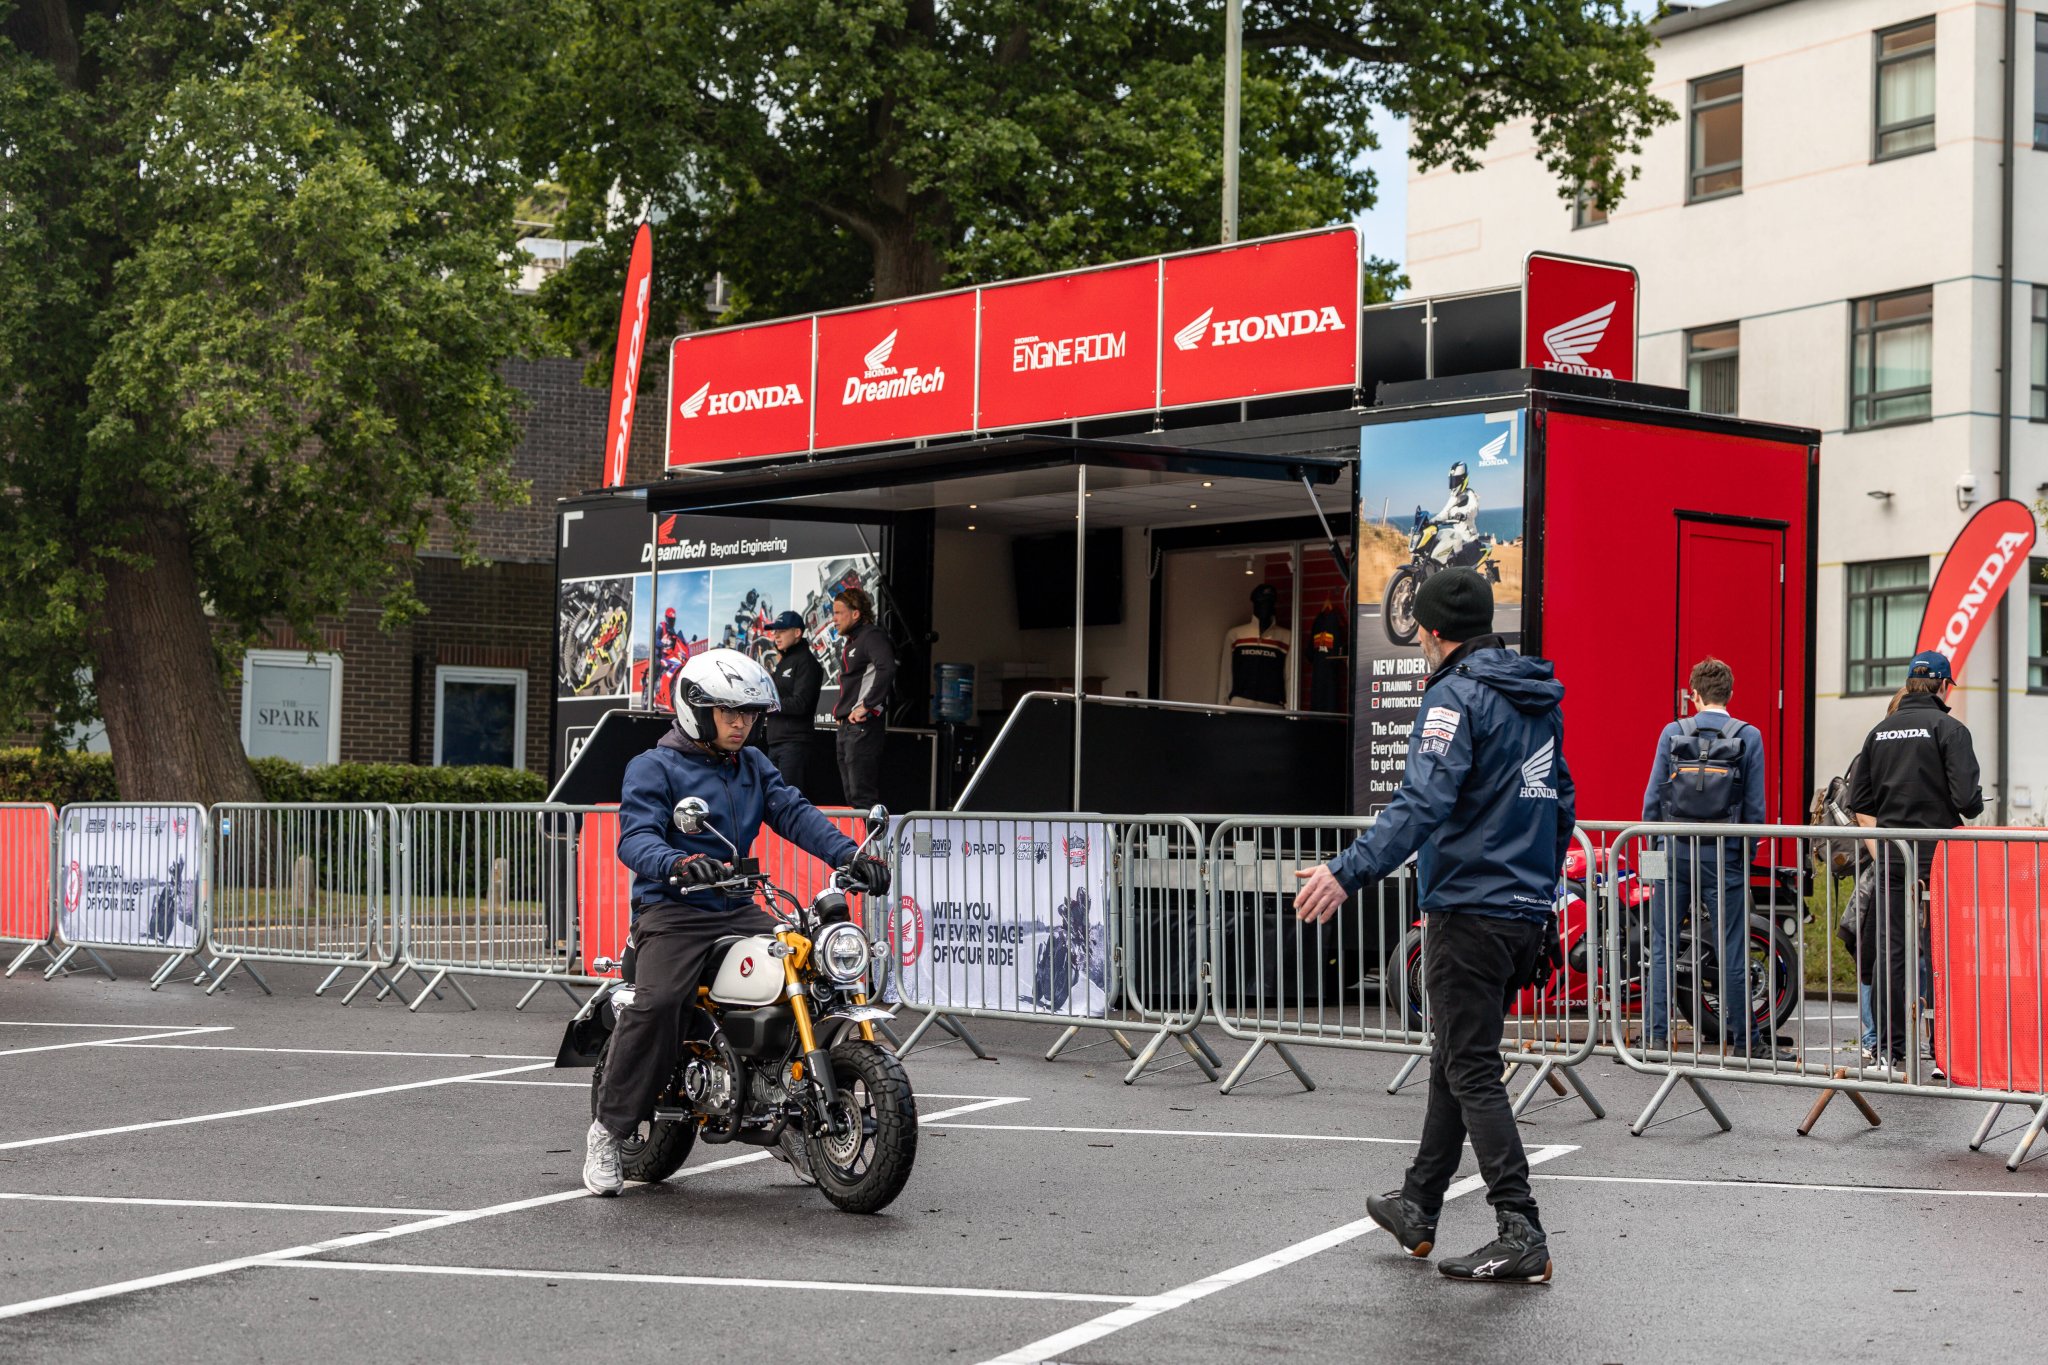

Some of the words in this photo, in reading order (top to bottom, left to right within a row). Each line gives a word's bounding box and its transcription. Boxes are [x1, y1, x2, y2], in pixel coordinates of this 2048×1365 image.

[1212, 306, 1345, 347] HONDA
[1014, 335, 1040, 345] HONDA
[1013, 338, 1073, 373] ENGINE
[1074, 331, 1126, 364] ROOM
[613, 272, 651, 487] ONDA
[864, 366, 898, 379] HONDA
[842, 366, 945, 406] DreamTech
[707, 383, 804, 416] HONDA
[1479, 458, 1509, 468] HONDA
[641, 539, 707, 563] DeamTech
[710, 540, 740, 559] Beyond
[741, 537, 788, 556] Engineering
[1241, 648, 1277, 658] HONDA
[1373, 659, 1395, 676] NEW
[1397, 658, 1426, 675] RIDER
[1381, 680, 1412, 692] TRAINING
[1381, 696, 1423, 708] MOTORCYCLE
[258, 708, 320, 728] SPARK
[1371, 721, 1387, 735] The
[1875, 728, 1931, 741] HONDA
[1371, 740, 1409, 758] Everythin
[1371, 758, 1379, 771] to
[1380, 757, 1394, 774] get
[1395, 760, 1406, 771] on
[1370, 780, 1385, 792] Chat
[1386, 780, 1393, 792] to
[1519, 786, 1558, 799] HONDA
[933, 901, 962, 920] WITH
[966, 902, 991, 921] YOU
[933, 923, 946, 941] AT
[987, 924, 1024, 945] STAGE
[933, 944, 948, 963] OF
[950, 945, 982, 965] YOUR
[987, 946, 1014, 967] RIDE
